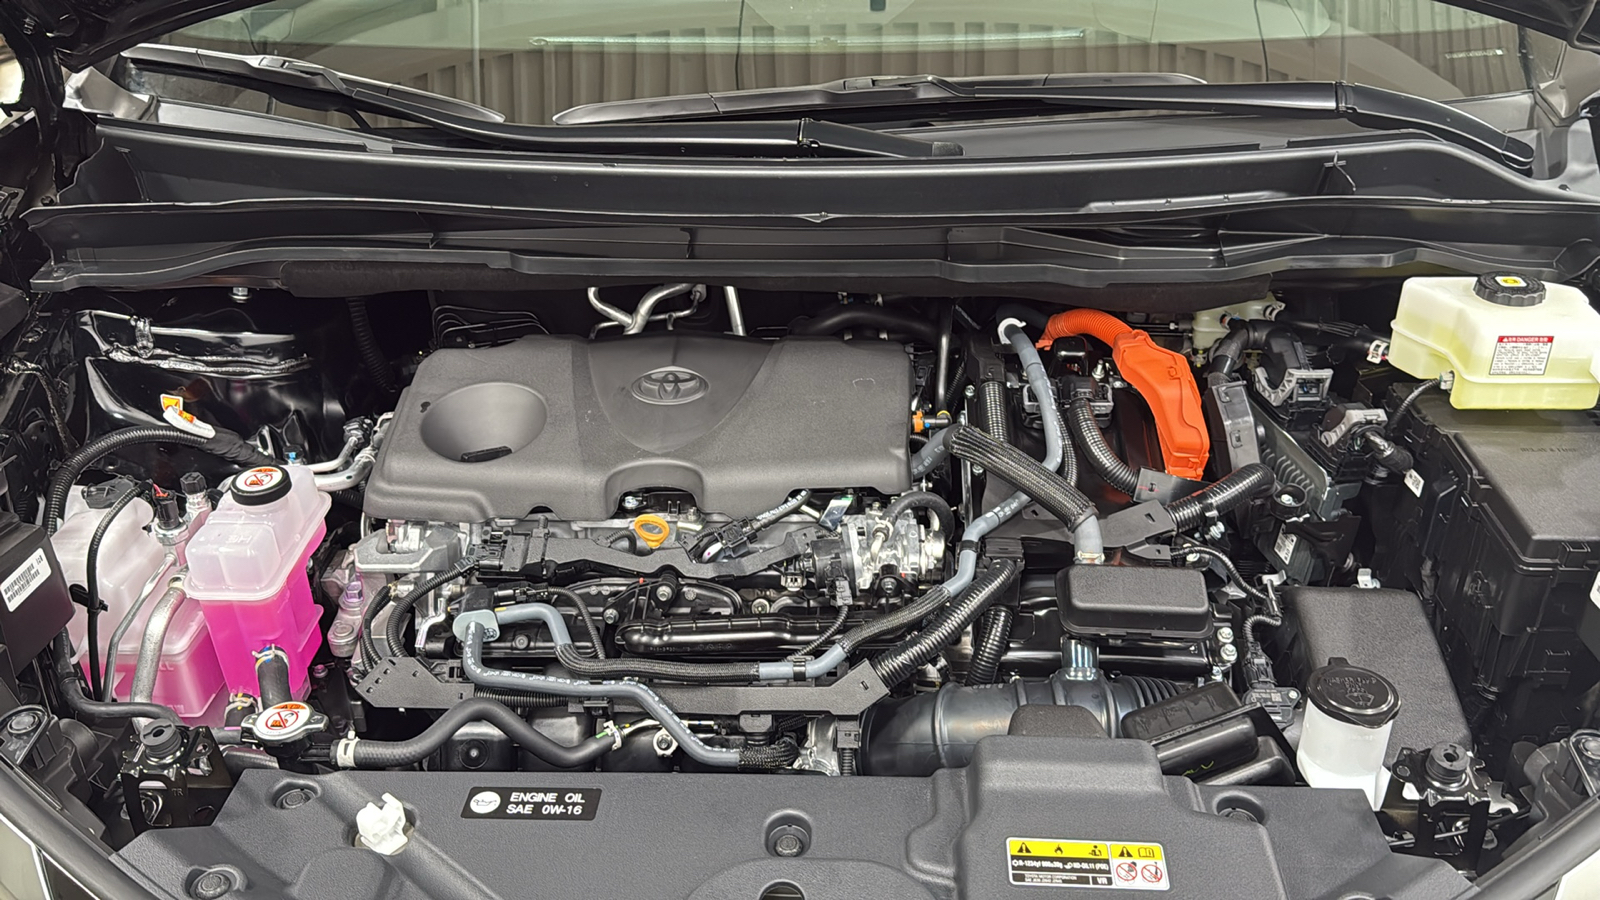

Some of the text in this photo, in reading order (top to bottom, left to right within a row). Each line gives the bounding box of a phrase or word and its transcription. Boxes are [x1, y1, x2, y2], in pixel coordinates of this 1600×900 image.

[509, 792, 586, 803] ENGINE OIL
[506, 804, 583, 815] SAE 0W-16
[1097, 877, 1107, 885] VR
